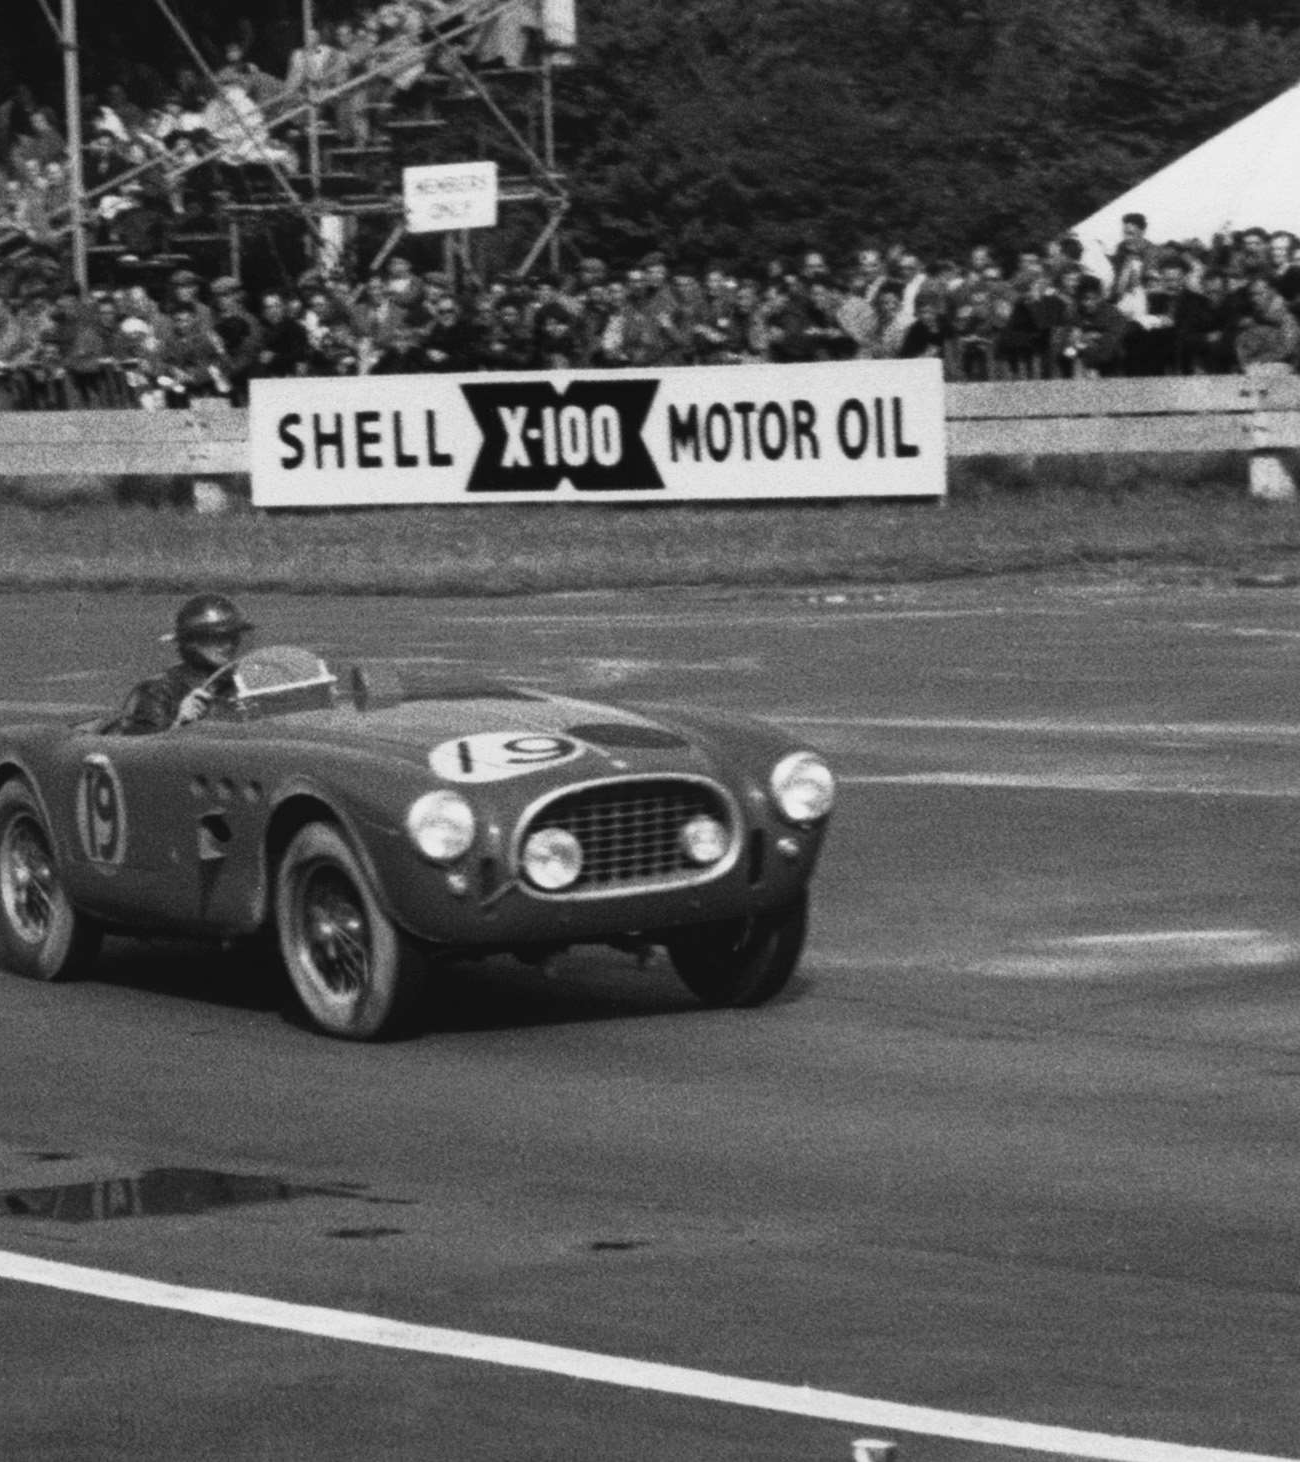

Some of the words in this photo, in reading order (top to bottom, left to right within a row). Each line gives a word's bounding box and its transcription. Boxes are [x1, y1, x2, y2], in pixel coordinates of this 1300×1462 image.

[277, 409, 454, 470] SHELL
[498, 404, 622, 468] X-100
[667, 400, 820, 463] MOTOR
[836, 396, 920, 460] OIL
[457, 737, 577, 774] 19
[84, 762, 118, 861] 19
